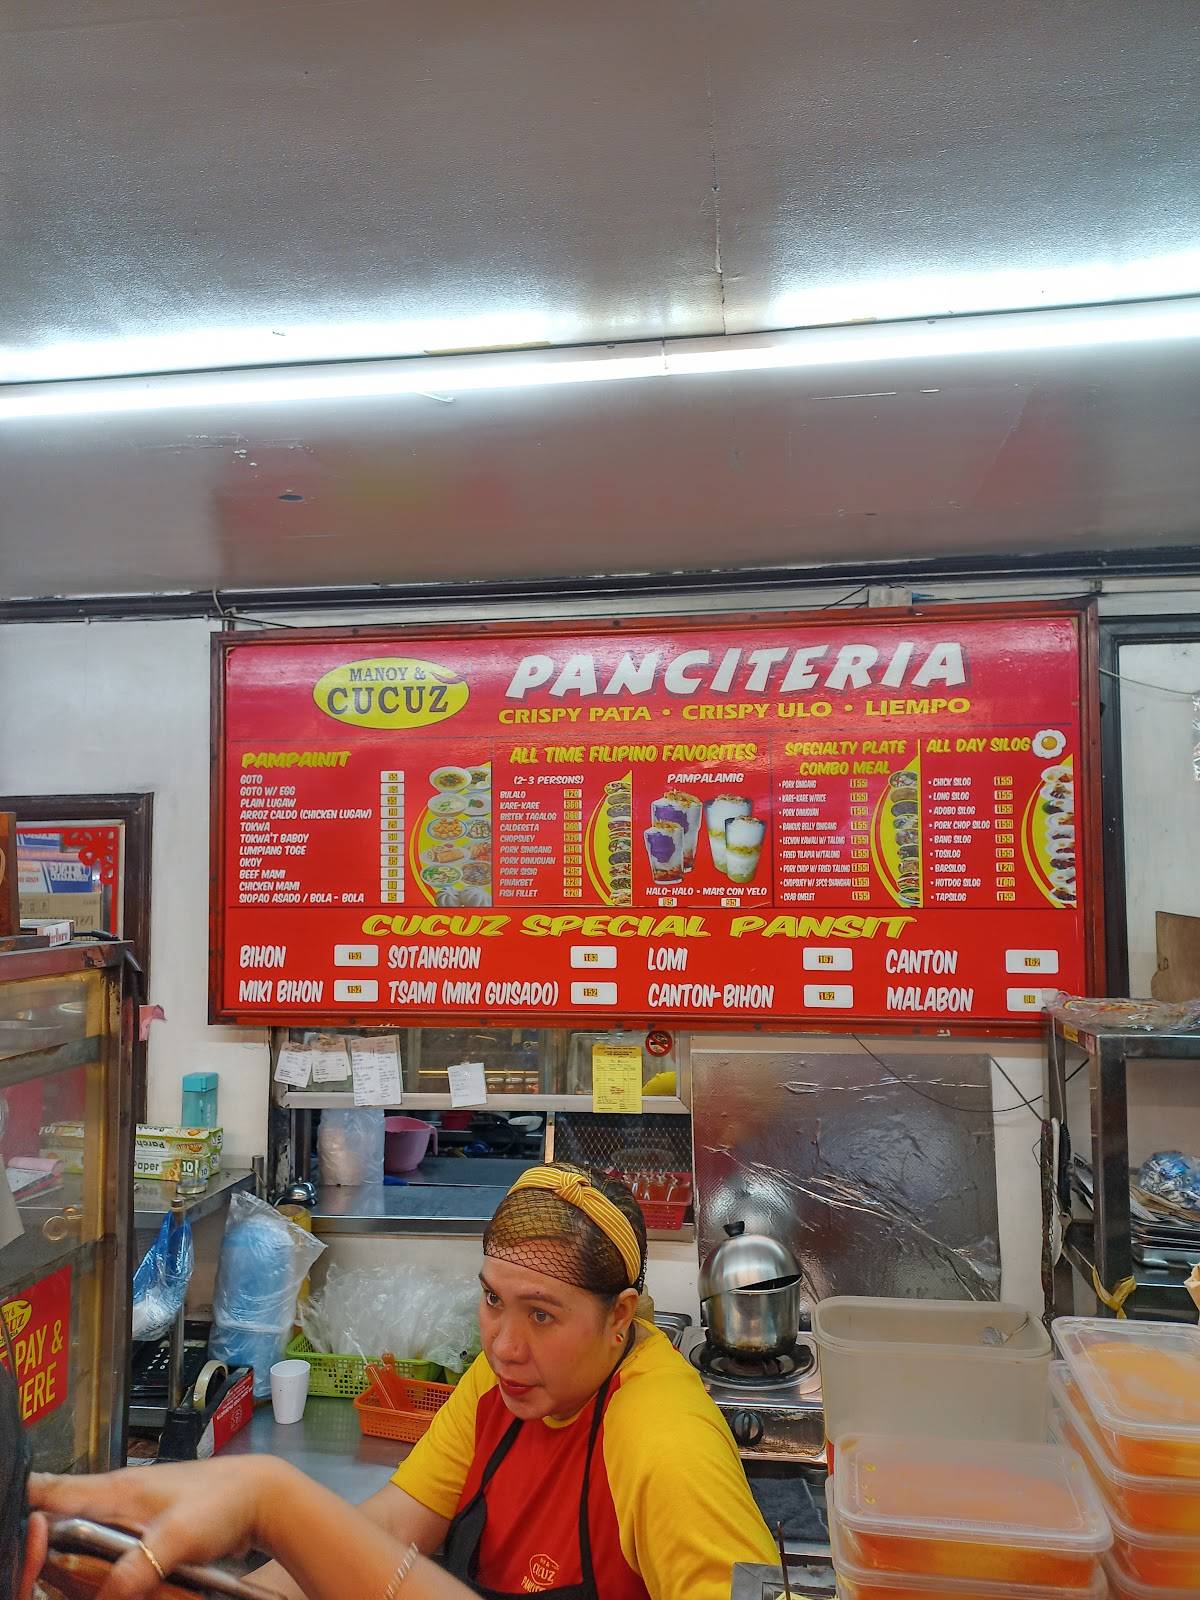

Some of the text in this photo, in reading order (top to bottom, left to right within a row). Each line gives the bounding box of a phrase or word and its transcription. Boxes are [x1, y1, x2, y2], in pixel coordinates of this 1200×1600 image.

[350, 667, 425, 682] MANOY &
[505, 642, 965, 698] PANCITERIA
[327, 685, 449, 714] CUCUZ
[499, 697, 971, 724] CRISPY PATA CRISPY ULO LIEMPO
[785, 740, 907, 756] SPECIALTY PLATE
[926, 737, 1031, 753] ALL DAY SILOG
[509, 742, 758, 763] ALL TIME FILIPINO FAVORITES
[241, 752, 351, 768] PAMPAINIT
[800, 761, 891, 776] COMBO MEAL
[240, 775, 262, 785] GOTO
[513, 775, 584, 784] (2-3 PERSONS)
[667, 773, 744, 783] PAMPALAMIG
[933, 777, 971, 786] CHICK SILOG
[240, 786, 296, 796] GOTO W/ EGG
[499, 791, 526, 799] BULALO
[933, 791, 969, 800] LONG SILOG
[240, 798, 296, 808] PLAIN LUGAW
[499, 802, 540, 810] KARE-KARE
[240, 809, 372, 820] ARROZ CALDO (CHICKEN LUGAW)
[933, 806, 975, 815] ADOBO SILOG
[525, 812, 557, 821] TAGALOG
[240, 822, 270, 832] TOKWA
[500, 823, 540, 832] CALDERETA
[934, 820, 990, 829] PORK CHOP SILOG
[240, 833, 309, 844] TOKWA'T BABOY
[500, 834, 535, 843] CHOPSUEY
[934, 835, 971, 844] BANG SILOG
[239, 845, 307, 856] LUMPIANG TOGE
[500, 845, 519, 854] PORK
[935, 849, 961, 858] TOSILOG
[239, 857, 262, 867] OKOY
[500, 856, 519, 865] PORK
[500, 868, 519, 876] PORK
[935, 864, 966, 873] BARSILOG
[239, 869, 286, 880] BEEF MAMI
[239, 881, 300, 891] CHICKEN MAMI
[935, 878, 981, 887] HOTDOG SILOG
[515, 890, 538, 898] FILLET
[646, 887, 768, 896] HALO-HALO MAIS CON YELO
[936, 892, 966, 901] TAPSILOG
[239, 893, 364, 904] SIOPAO ASADO BOLA BOLA
[362, 914, 920, 938] CUCUZ SPECIAL PANSIT
[240, 945, 287, 968] BIHON
[387, 946, 481, 969] SOTANGHON
[647, 947, 687, 971] LOMI
[886, 948, 958, 974] CANTON
[239, 980, 323, 1003] MIKI BIHON
[388, 980, 558, 1006] TSAMI (MIKI GUISADO)
[647, 983, 774, 1008] CANTON-BIHON
[887, 986, 974, 1011] MALABON
[182, 1161, 194, 1173] 10
[15, 1324, 48, 1379] PAY
[51, 1319, 63, 1354] &
